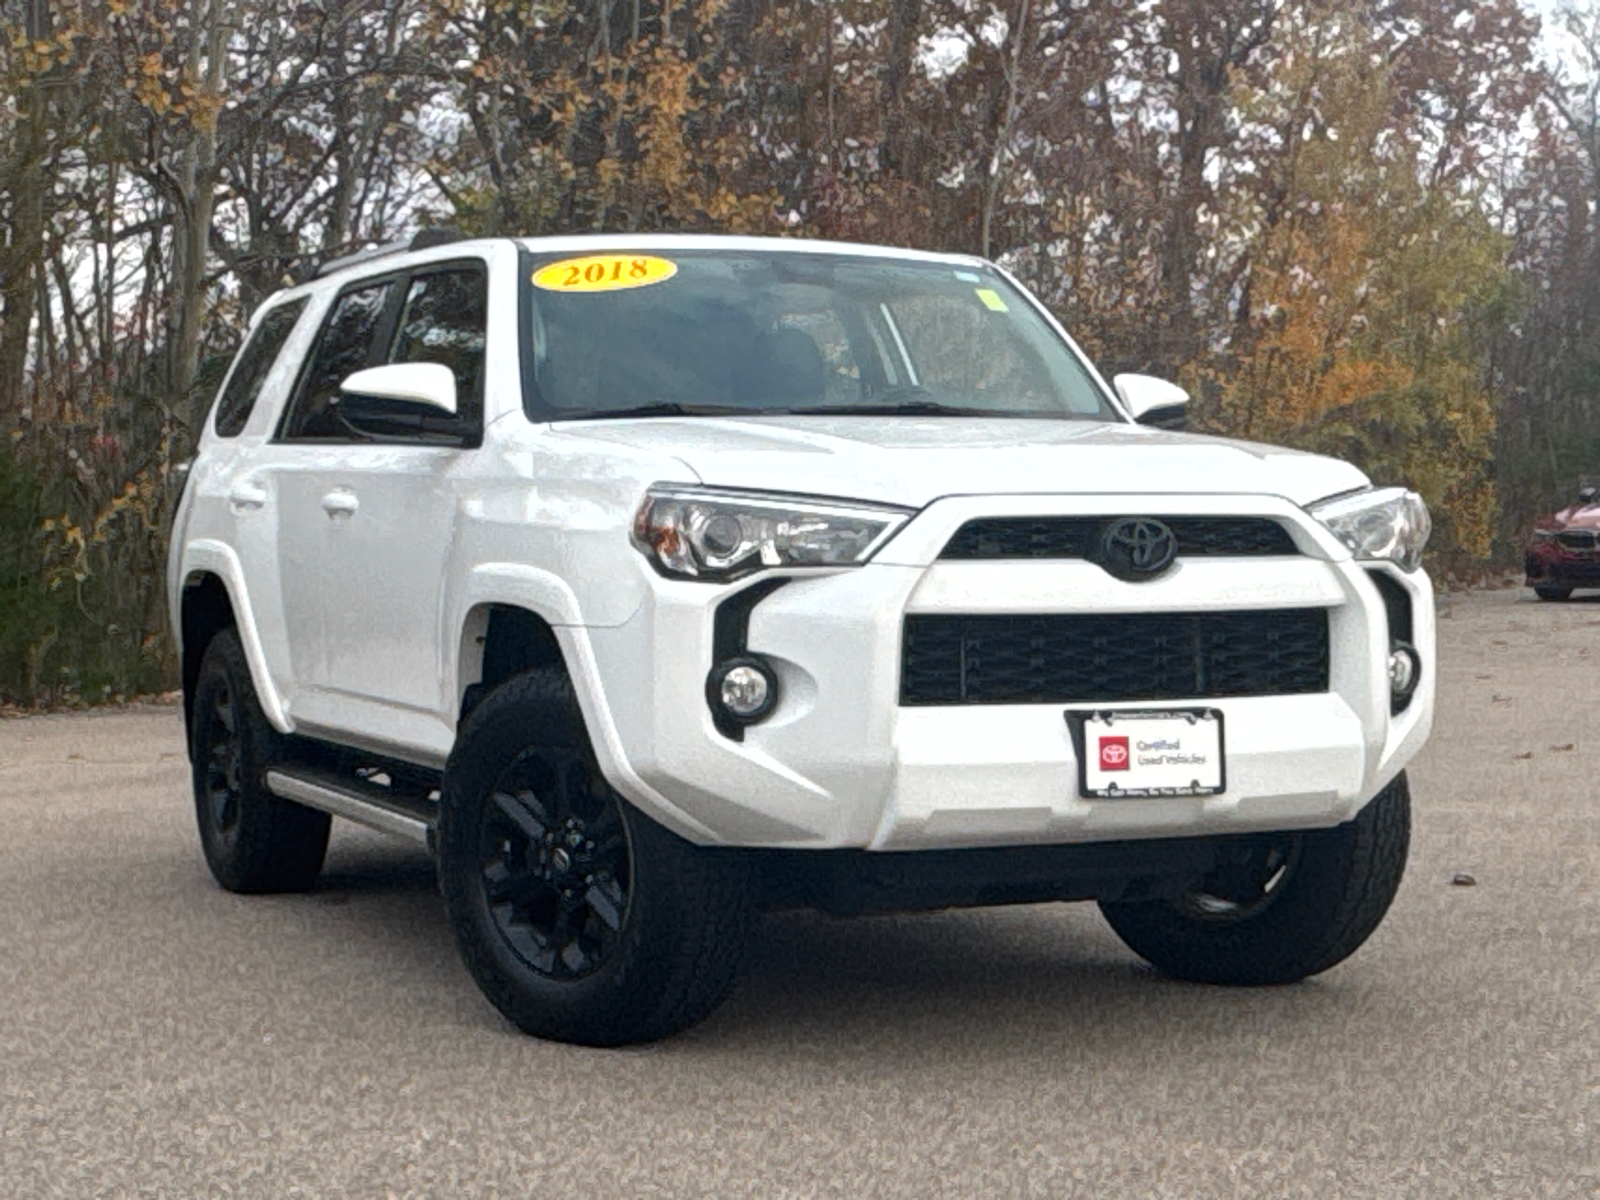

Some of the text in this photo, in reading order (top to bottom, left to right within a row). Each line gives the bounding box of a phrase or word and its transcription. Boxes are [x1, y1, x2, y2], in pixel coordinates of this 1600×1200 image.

[563, 260, 648, 286] 2018
[1136, 739, 1180, 751] Certified
[1163, 754, 1206, 765] Vehicles
